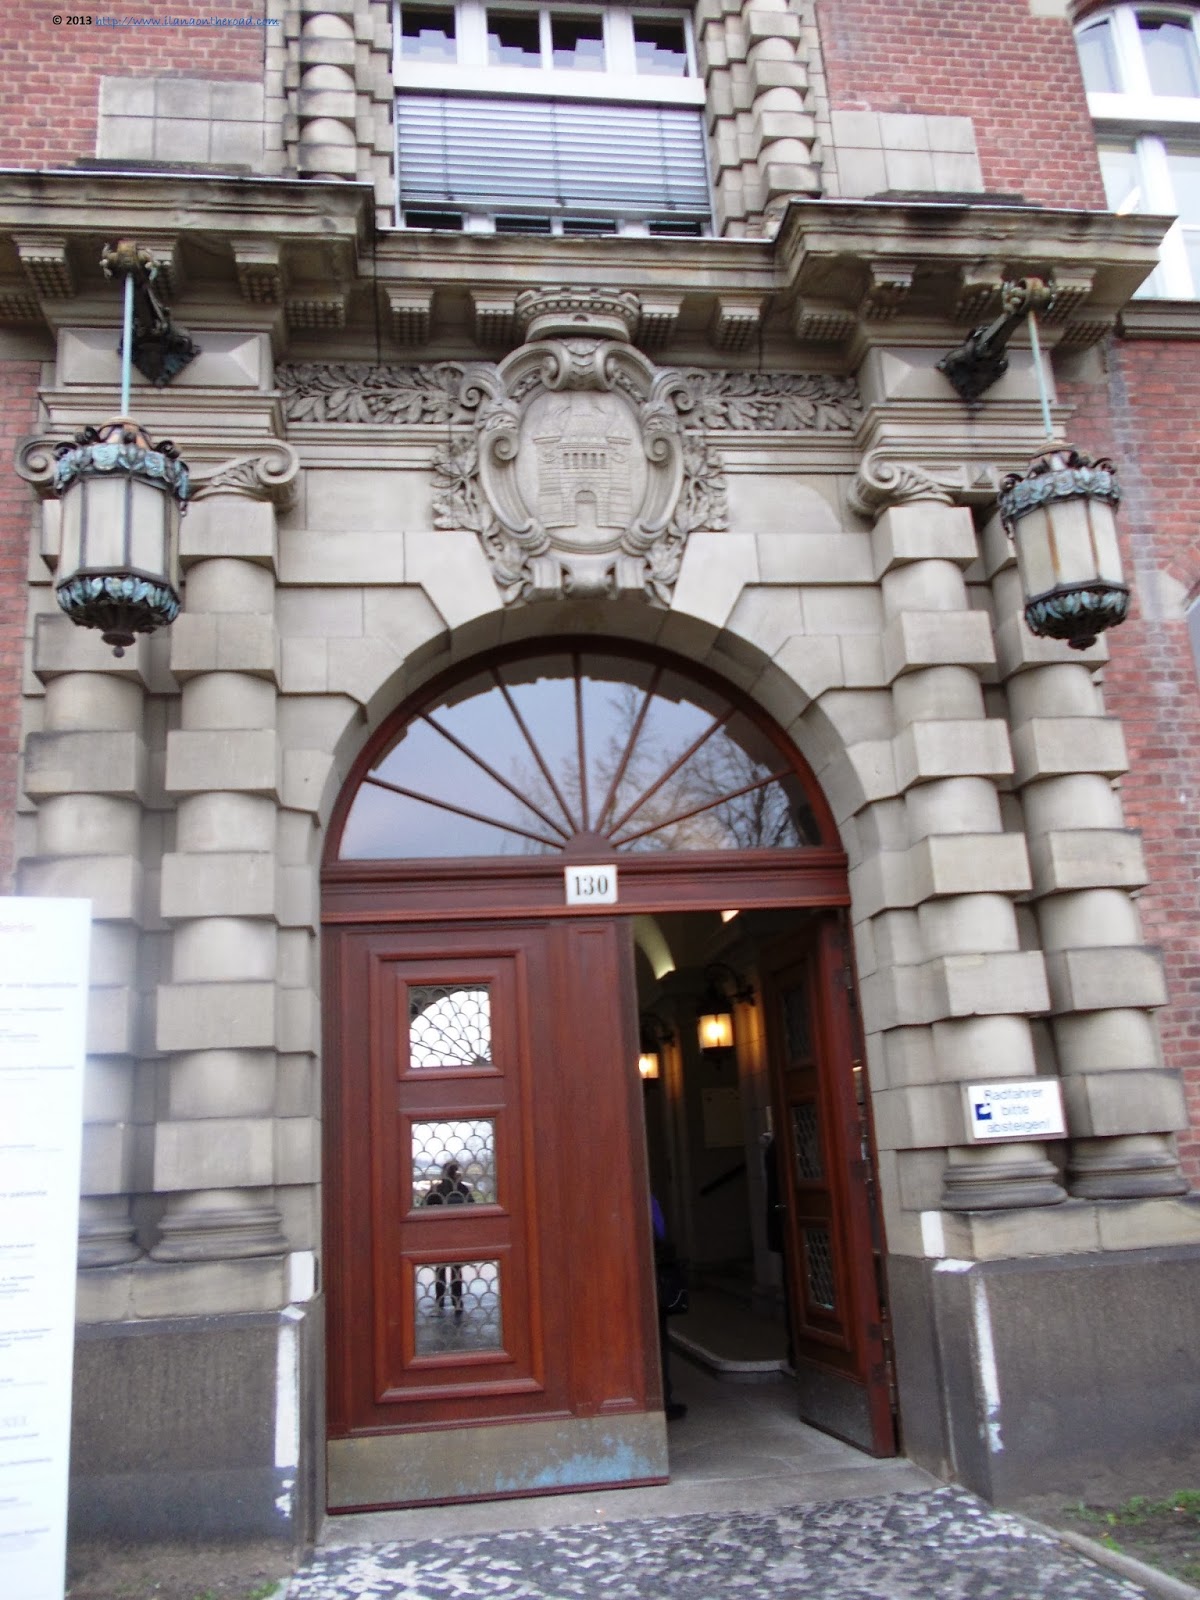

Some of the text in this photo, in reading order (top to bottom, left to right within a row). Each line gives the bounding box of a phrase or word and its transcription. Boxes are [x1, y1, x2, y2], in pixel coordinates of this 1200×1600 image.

[575, 875, 609, 896] 130
[984, 1088, 1044, 1101] Radfahrer
[1001, 1103, 1030, 1116] bitte
